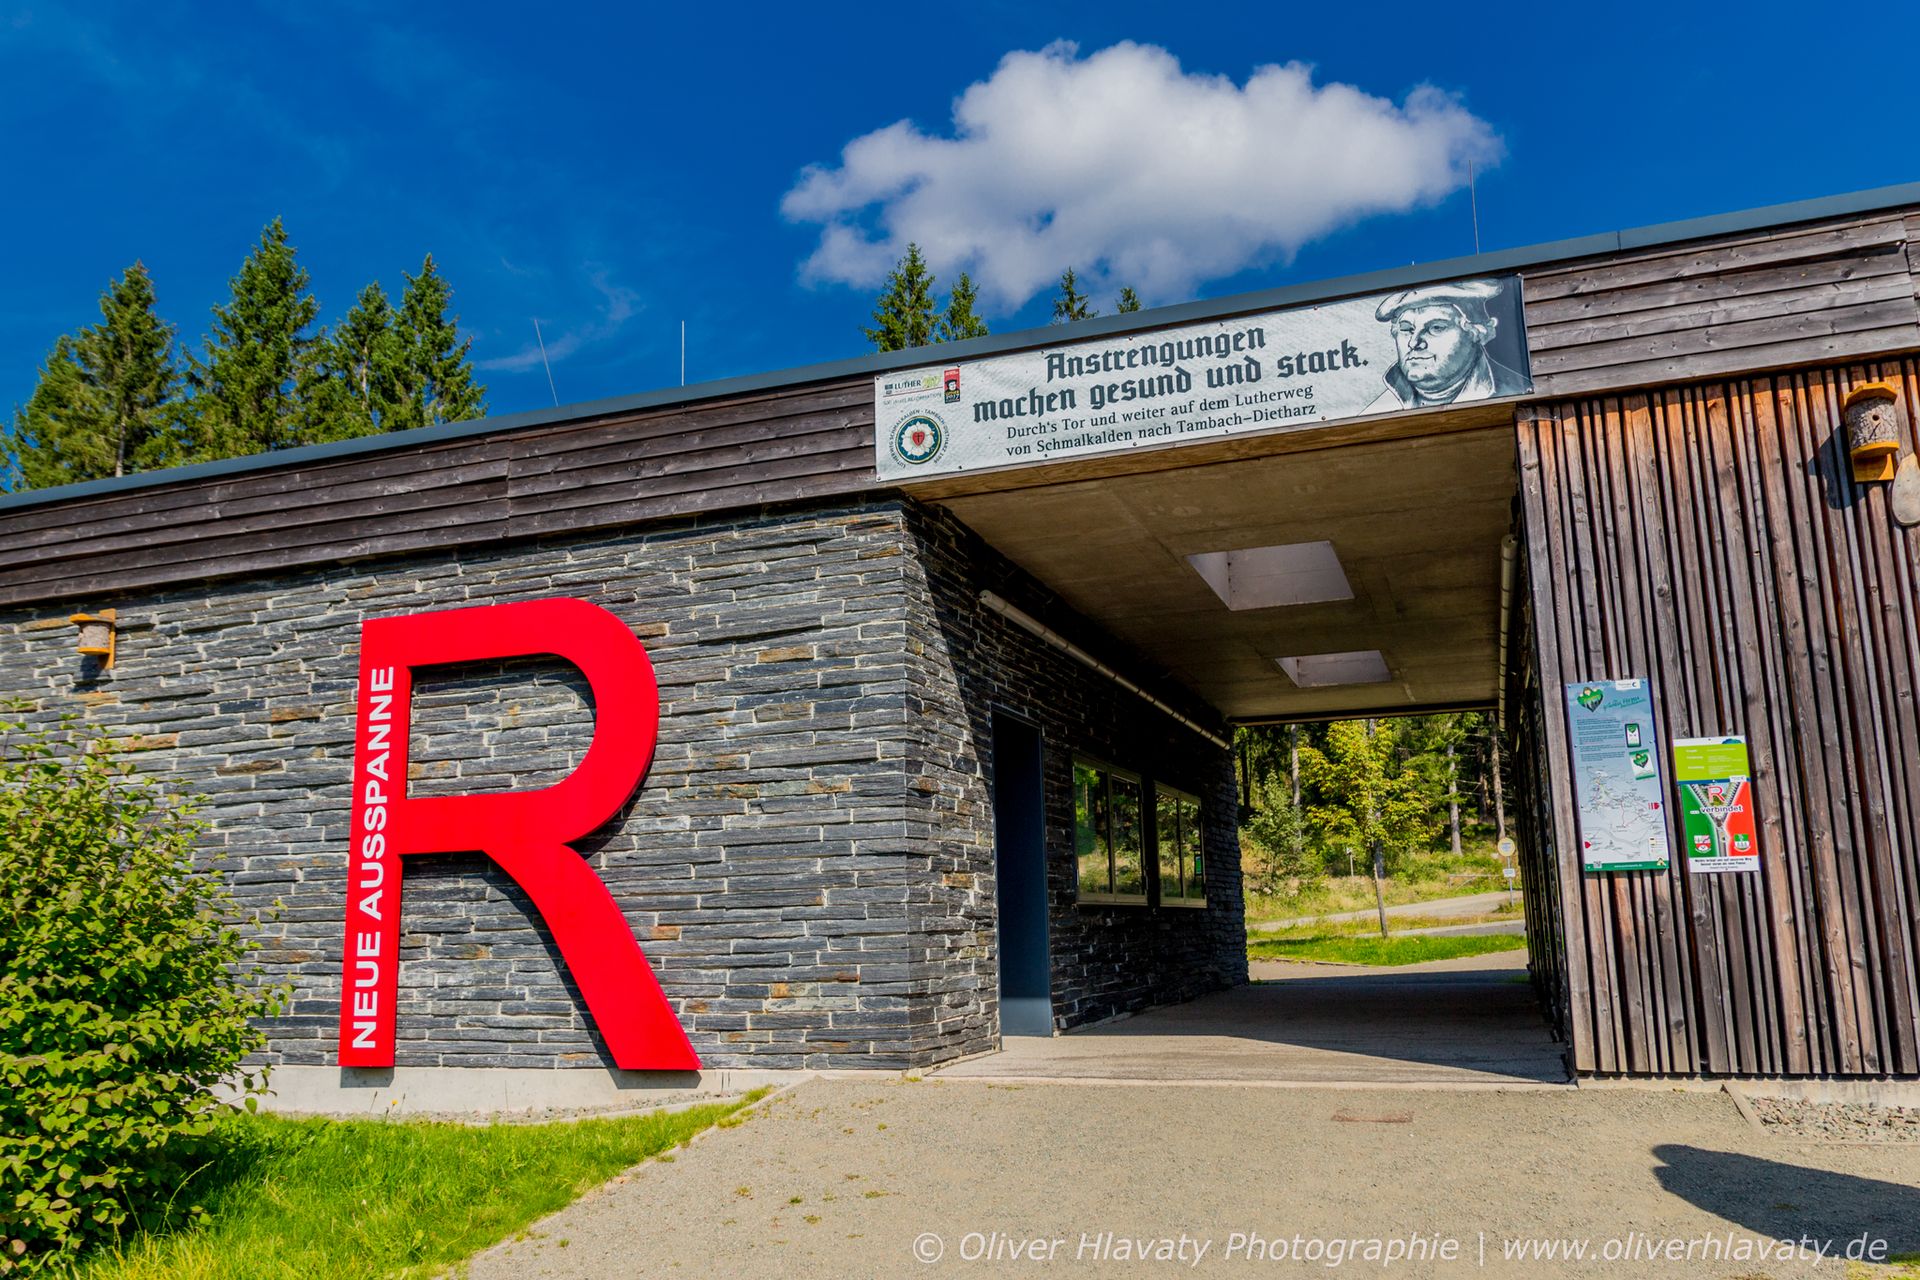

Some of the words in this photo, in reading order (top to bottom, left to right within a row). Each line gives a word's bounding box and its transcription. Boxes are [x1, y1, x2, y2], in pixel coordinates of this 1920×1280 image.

[973, 387, 1077, 423] machen
[1090, 366, 1193, 411] gesund
[1207, 355, 1262, 389] und
[1276, 338, 1369, 378] stark.
[1045, 327, 1266, 383] Anstrengungen
[894, 380, 922, 390] LUTHER
[1062, 419, 1085, 431] Tor
[1090, 412, 1116, 427] und
[1121, 408, 1166, 423] weiter
[1170, 400, 1195, 415] auf
[1200, 397, 1229, 412] dem
[1235, 385, 1314, 407] Lutherweg
[1006, 445, 1031, 457] von
[1037, 431, 1132, 452] Schmalkalden
[1138, 424, 1172, 438] nach
[359, 666, 394, 920] AUSSPANNE
[352, 931, 382, 1049] NEUE
